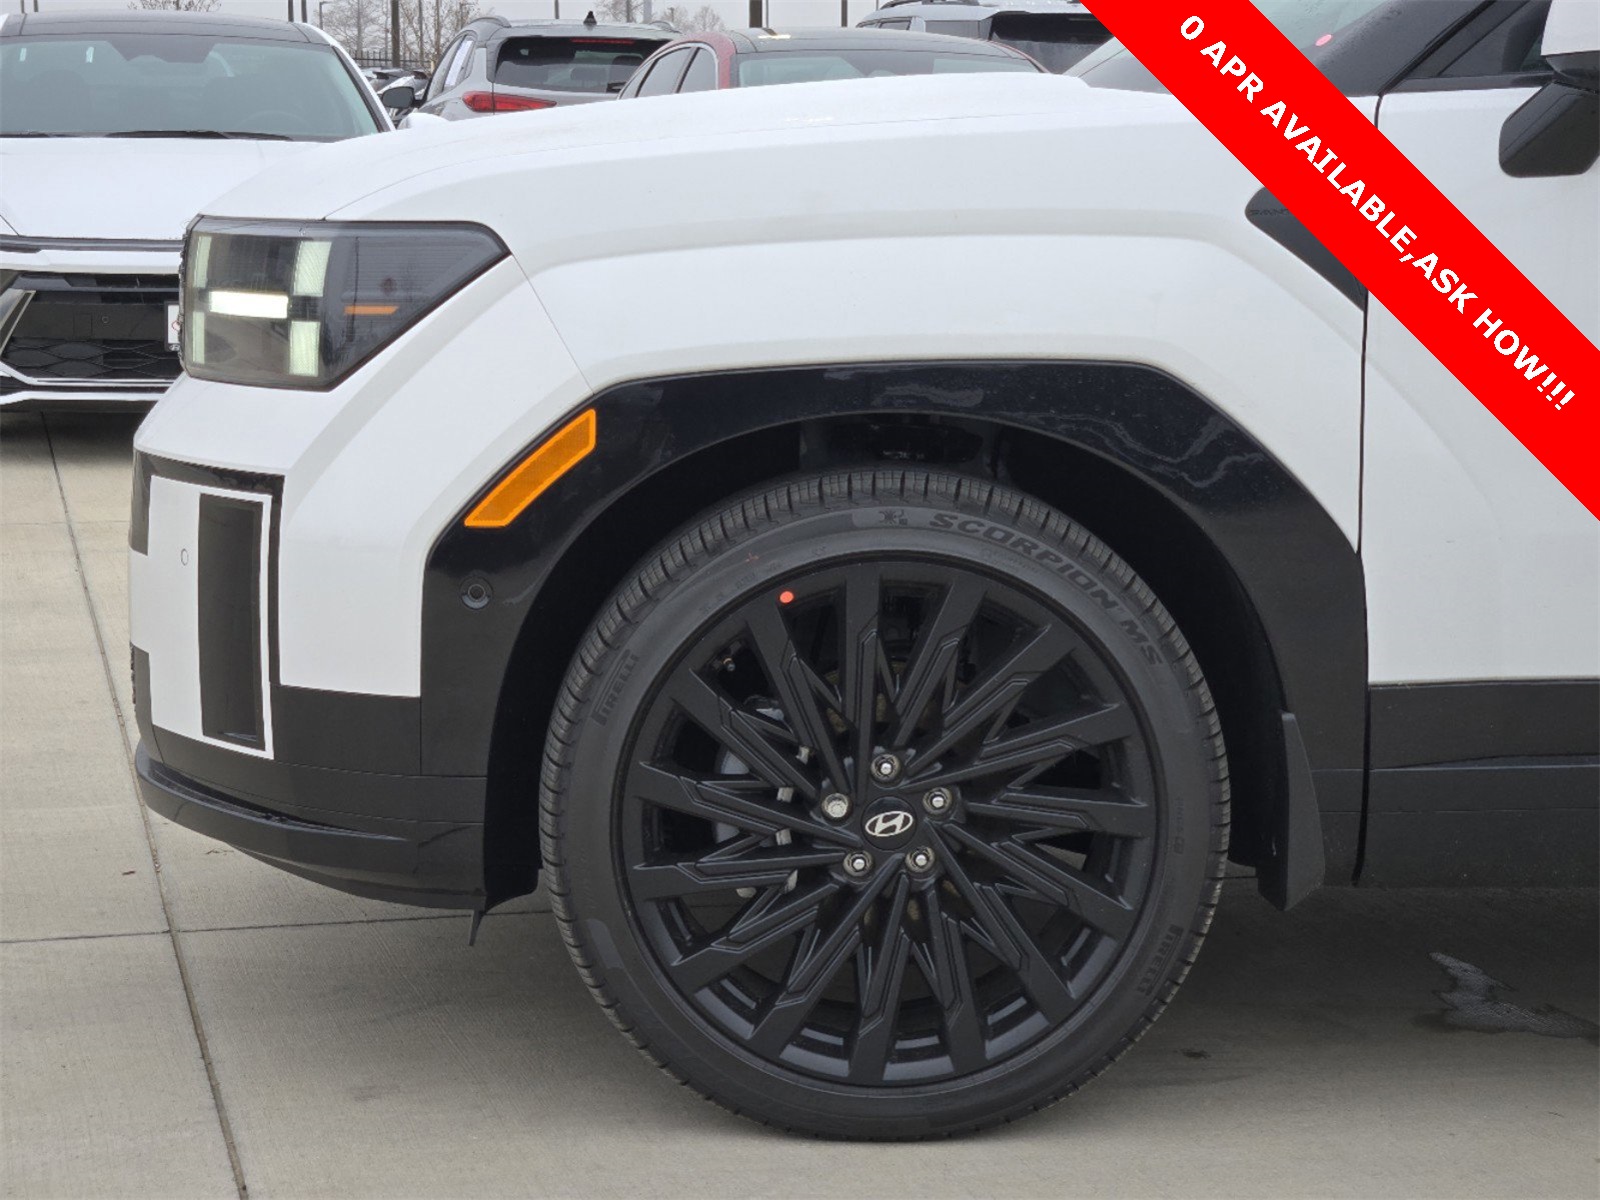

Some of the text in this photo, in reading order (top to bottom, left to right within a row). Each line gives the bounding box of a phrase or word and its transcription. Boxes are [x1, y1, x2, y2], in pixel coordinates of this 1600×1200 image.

[930, 513, 1118, 609] SCORPION
[1121, 620, 1163, 665] MS
[590, 648, 639, 726] PIRELLI
[1137, 924, 1184, 996] PIRELLI
